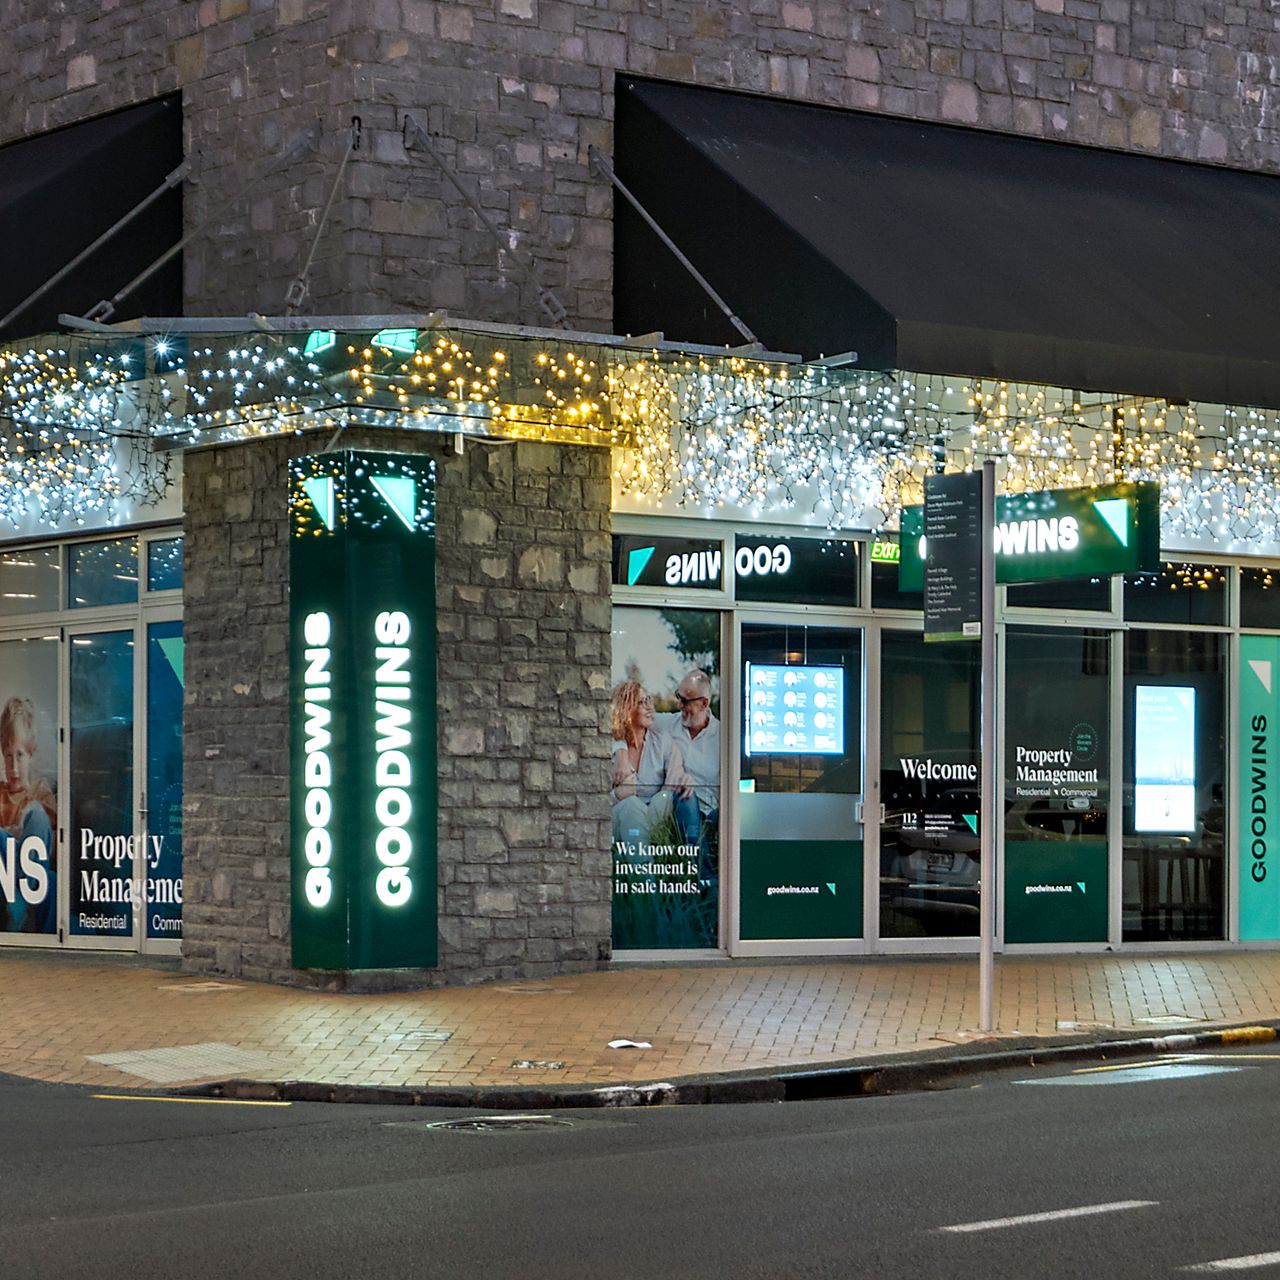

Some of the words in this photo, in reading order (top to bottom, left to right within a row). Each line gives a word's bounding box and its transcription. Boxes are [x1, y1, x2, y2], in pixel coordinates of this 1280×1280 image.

[871, 542, 895, 558] EXIT
[304, 611, 332, 908] GOODWINS
[375, 610, 412, 908] GOODWINS
[1016, 746, 1073, 767] Property
[900, 758, 977, 780] Welcome
[1016, 765, 1098, 786] Management
[1016, 787, 1051, 796] Residential
[1061, 787, 1098, 797] Commercial
[1252, 715, 1267, 883] GOODWINS
[902, 813, 917, 824] 112
[80, 828, 164, 869] Property
[638, 841, 676, 857] know
[677, 844, 700, 857] our
[615, 860, 685, 875] investment
[687, 860, 698, 875] is
[80, 870, 183, 912] Manageme
[615, 879, 628, 894] in
[631, 879, 657, 894] safe
[767, 885, 819, 896] goodwins.co.nz
[1025, 884, 1073, 895] goodwins.co.nz
[79, 913, 127, 929] Residential
